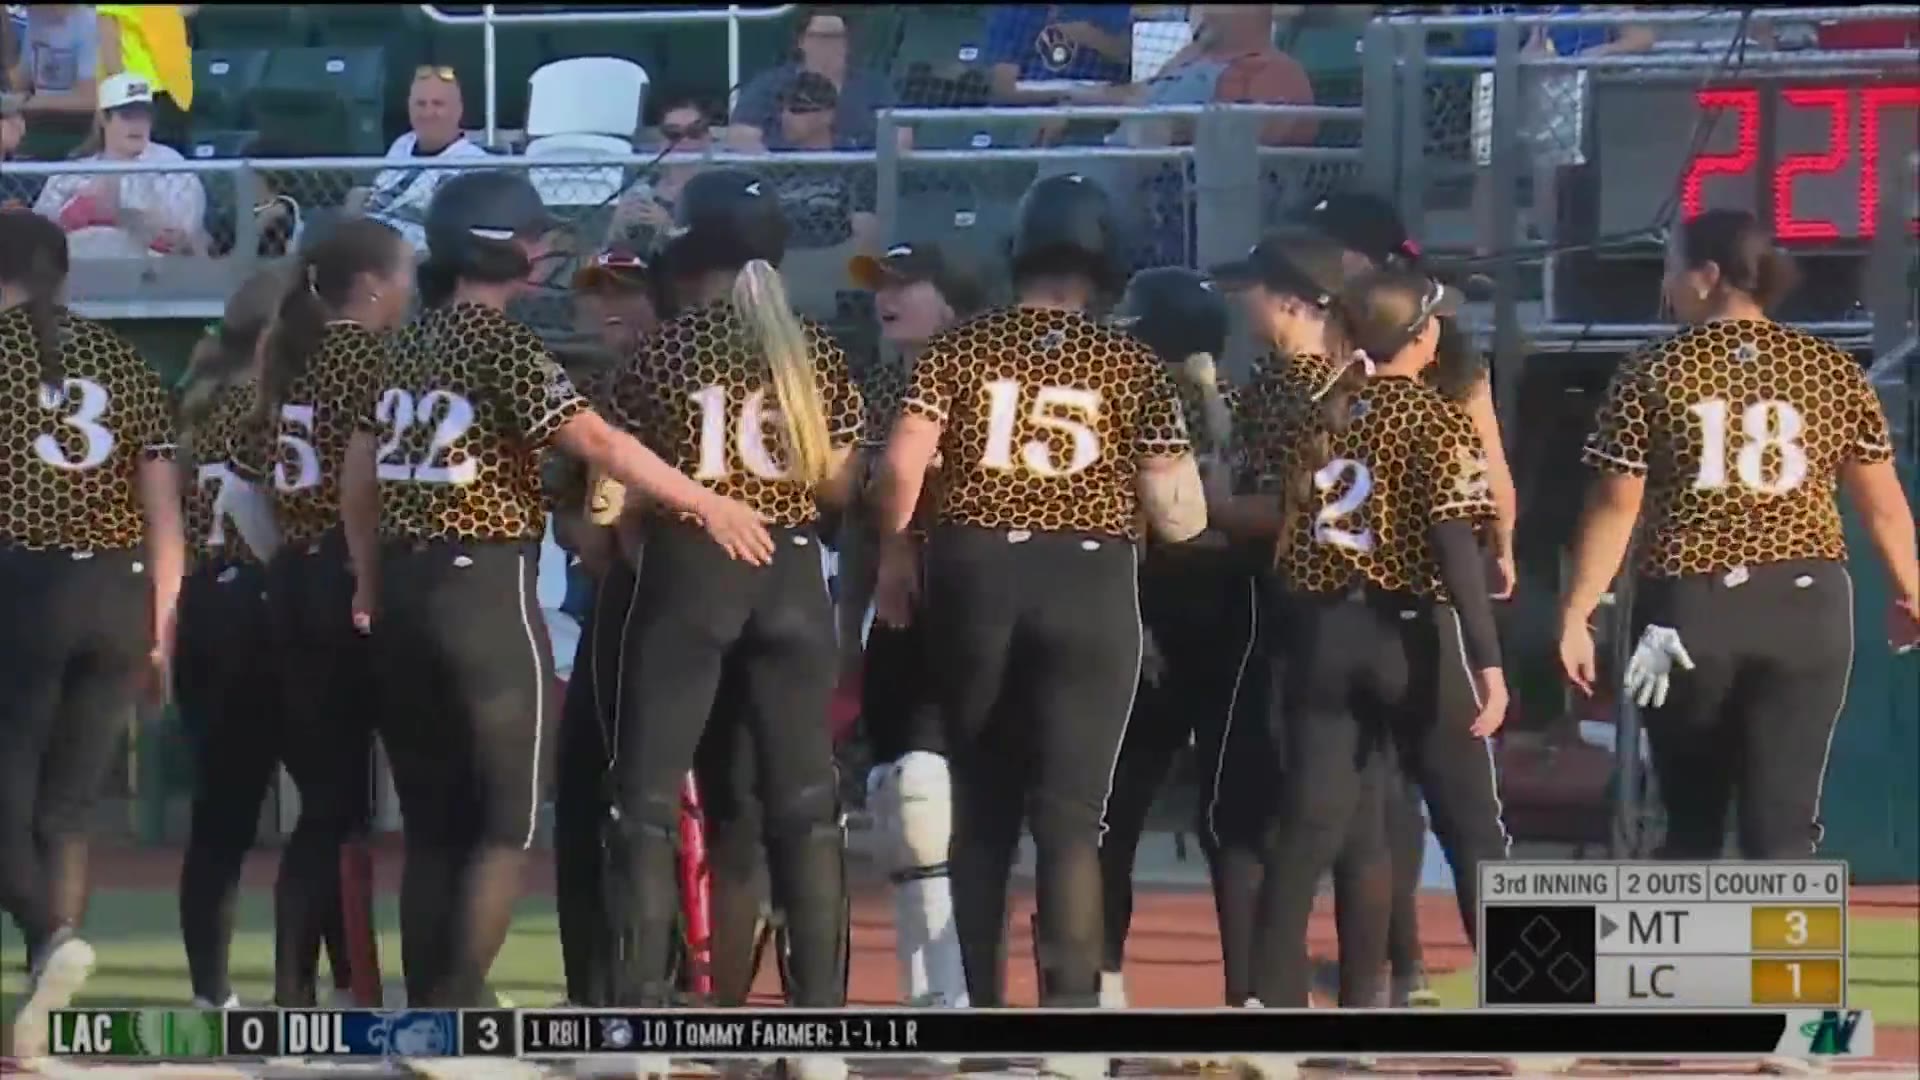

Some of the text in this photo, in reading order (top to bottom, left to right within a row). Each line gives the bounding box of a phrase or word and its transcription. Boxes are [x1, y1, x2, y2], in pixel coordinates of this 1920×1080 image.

[34, 378, 114, 469] 3
[376, 387, 478, 483] 22
[688, 384, 792, 480] 16
[980, 379, 1101, 475] 15
[1690, 399, 1808, 494] 18
[1314, 458, 1374, 551] 2
